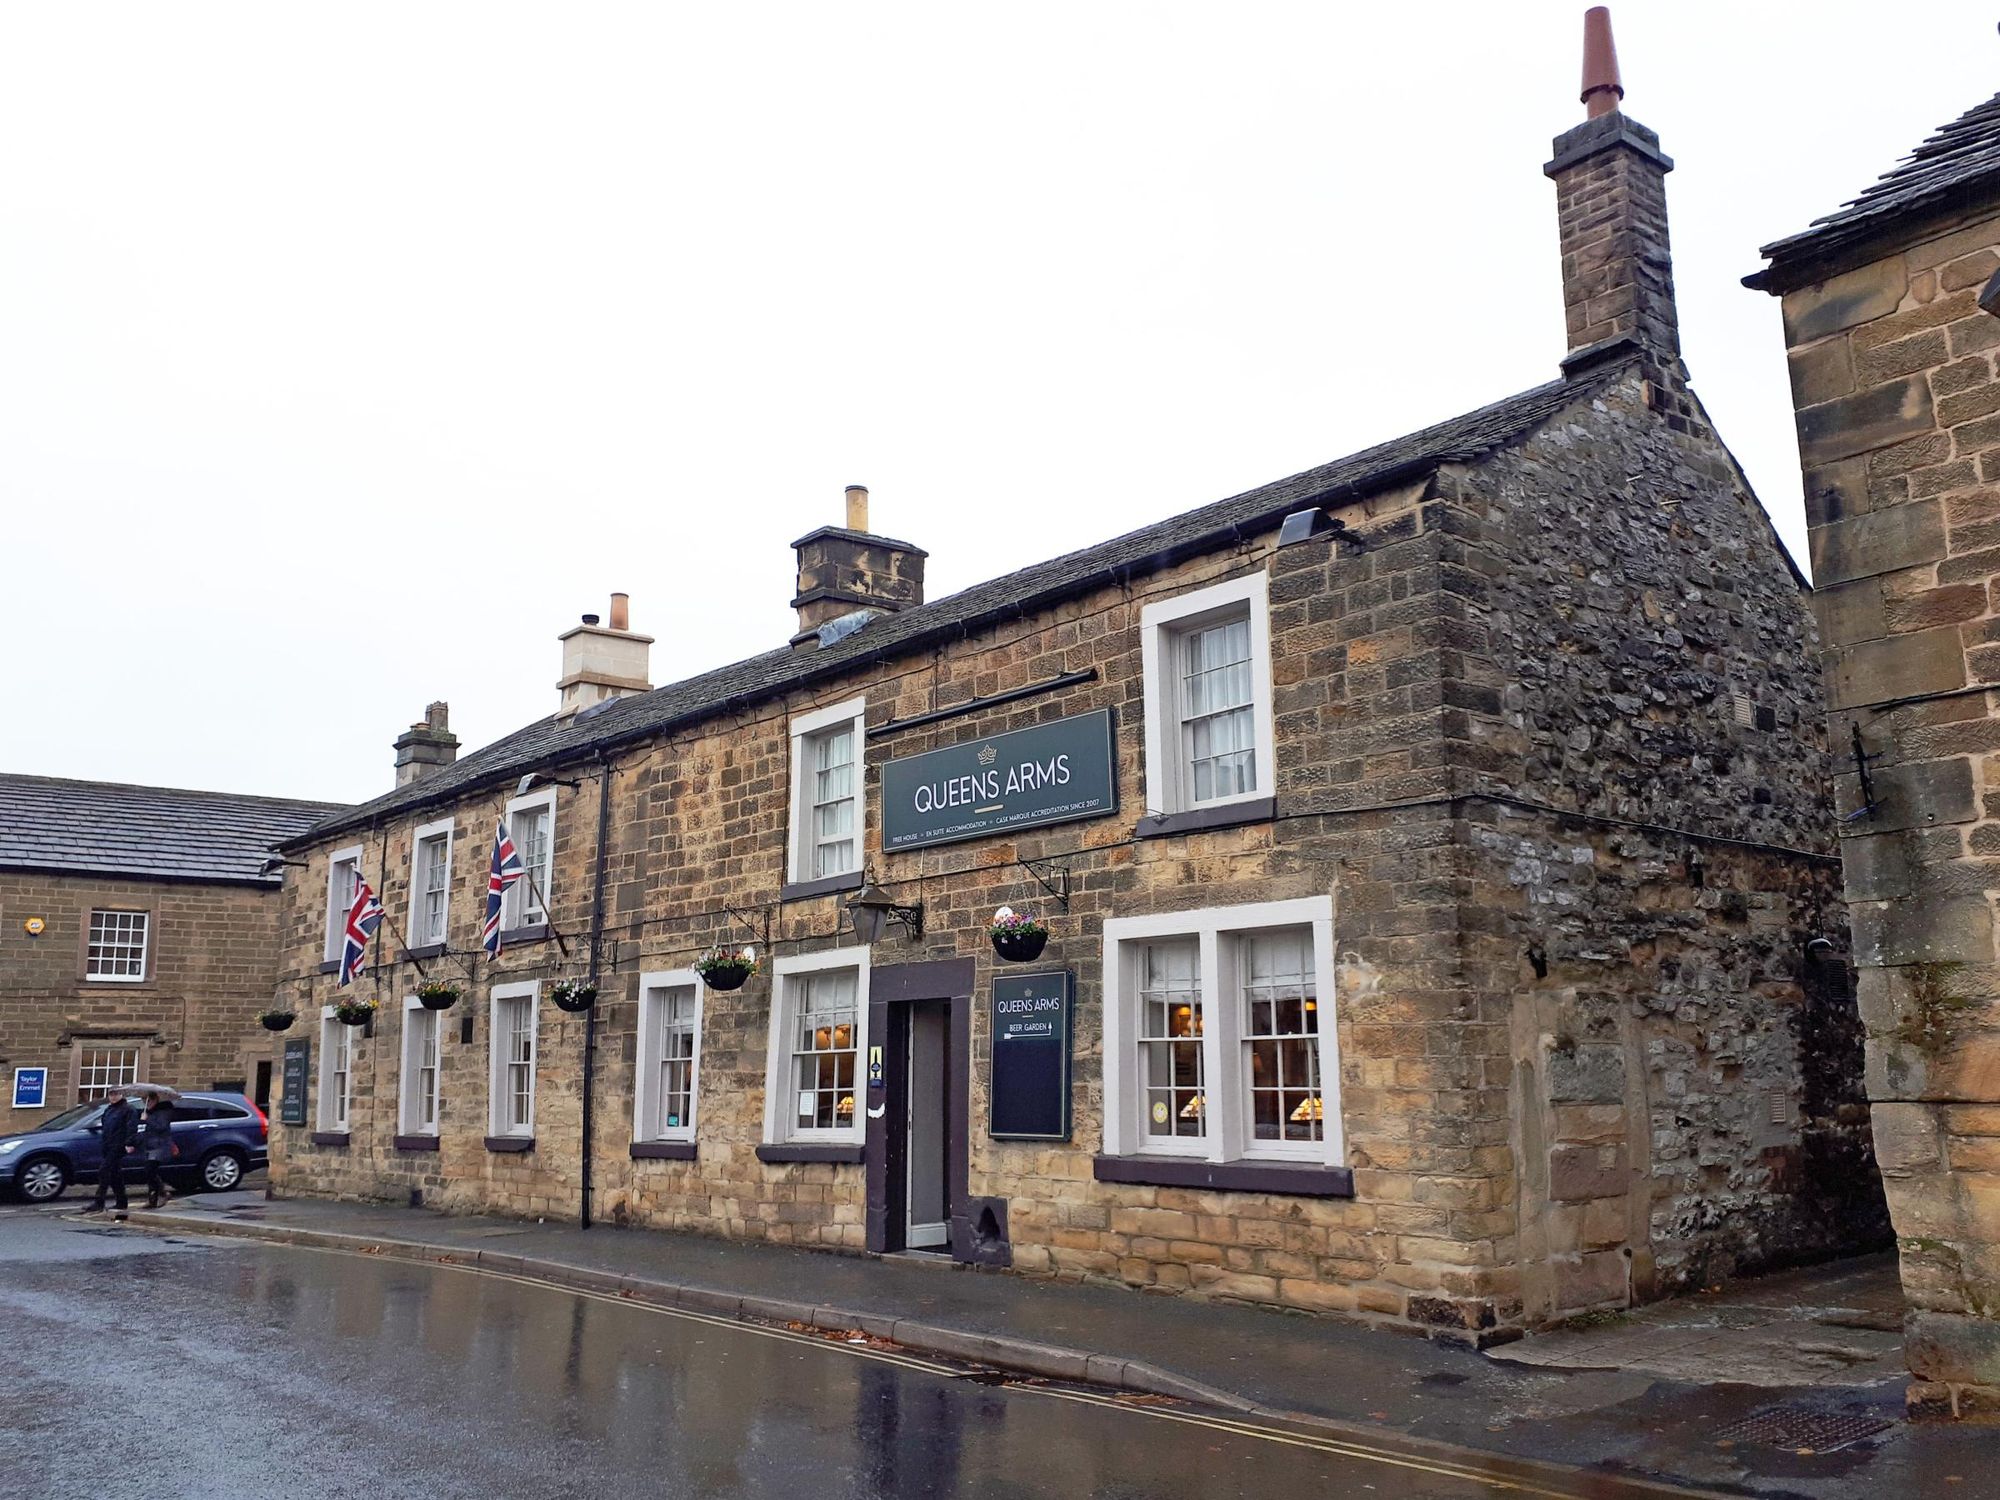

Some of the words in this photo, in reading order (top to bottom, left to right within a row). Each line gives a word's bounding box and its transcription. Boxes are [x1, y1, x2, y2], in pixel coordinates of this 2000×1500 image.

[914, 770, 1000, 813] QUEENS
[1005, 754, 1071, 796] ARMS
[903, 832, 918, 842] HOUSE
[932, 827, 945, 836] SUITE
[946, 820, 987, 833] ACCOMMODATION
[1009, 811, 1030, 822] MARQUE
[1030, 804, 1070, 818] ACCREDITATION
[1070, 801, 1085, 812] SINCE
[1086, 798, 1100, 808] 2007
[998, 1000, 1033, 1014] QUEENS
[1034, 997, 1060, 1011] ARMS
[1009, 1023, 1023, 1032] BEER
[1024, 1022, 1047, 1031] GARDEN
